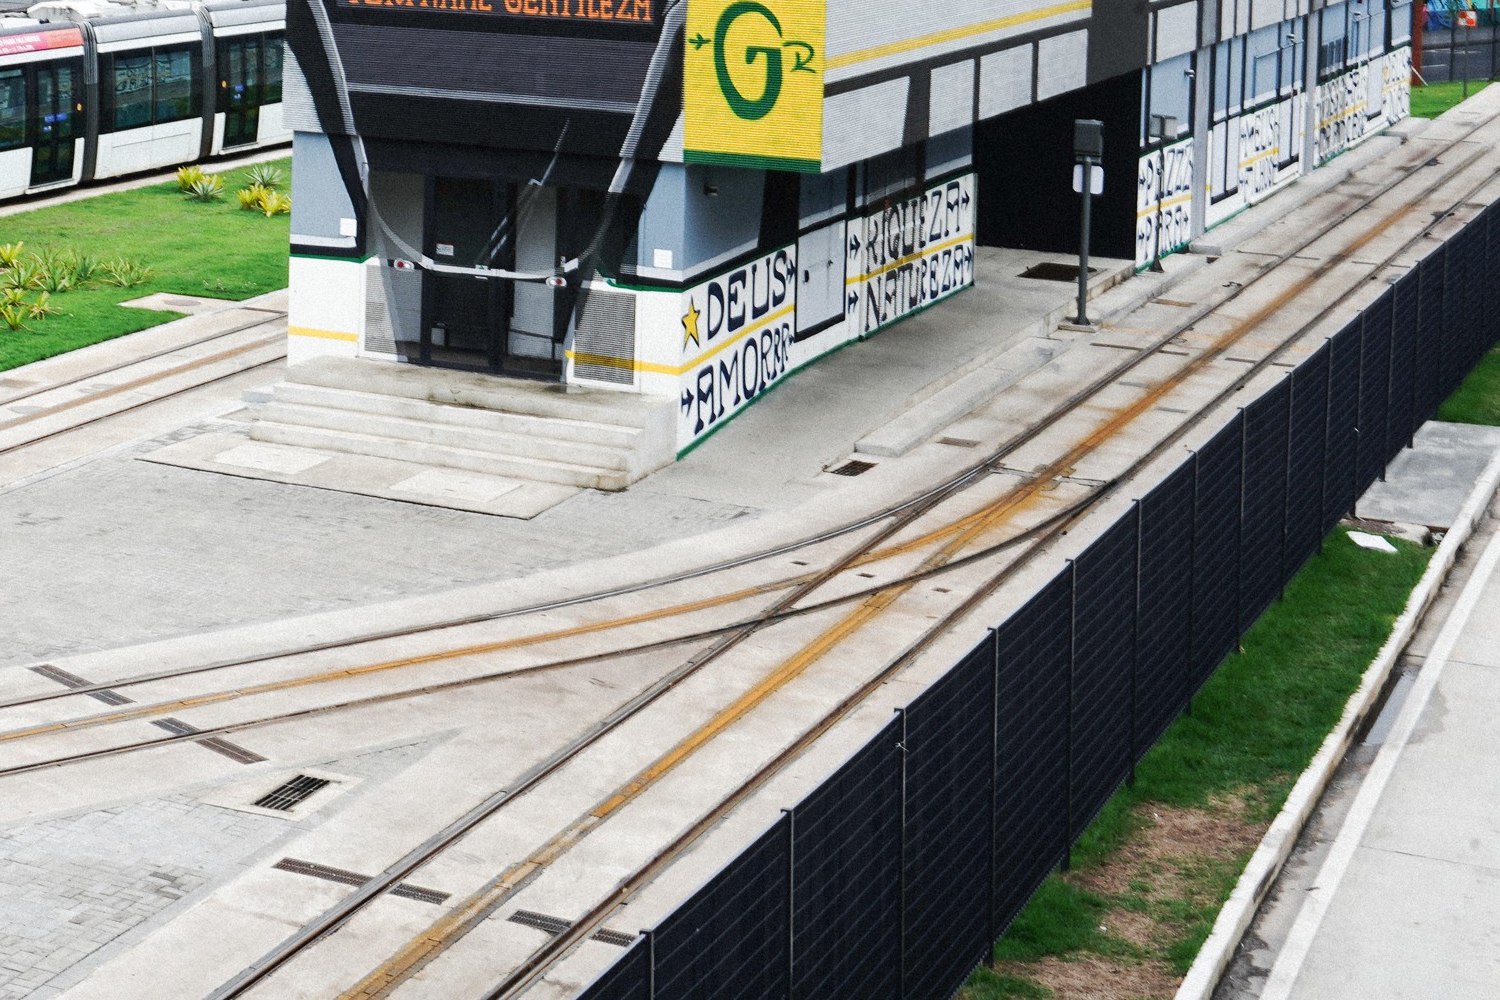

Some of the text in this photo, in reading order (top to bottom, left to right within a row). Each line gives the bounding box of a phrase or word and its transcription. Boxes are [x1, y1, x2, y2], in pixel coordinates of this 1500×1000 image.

[865, 181, 962, 273] RIQUEZA
[706, 250, 788, 341] DEUS
[864, 244, 964, 331] NATUREZA
[694, 322, 790, 436] AMORRR
